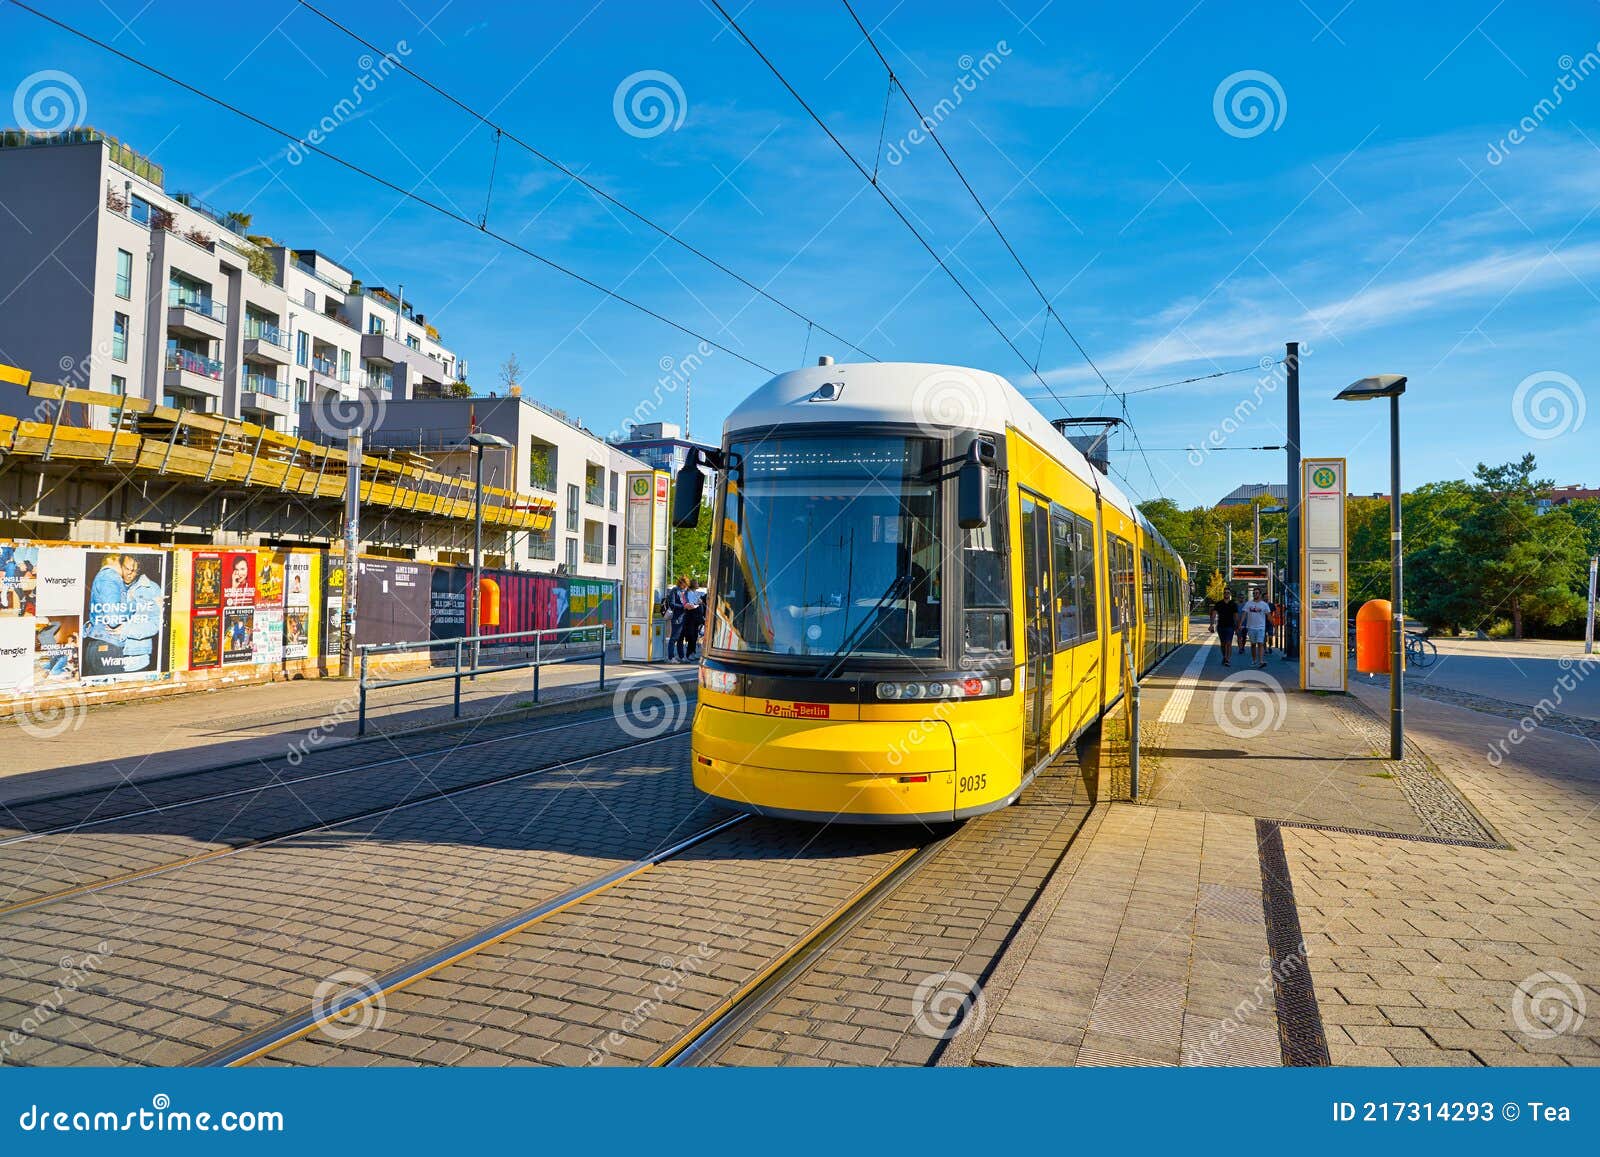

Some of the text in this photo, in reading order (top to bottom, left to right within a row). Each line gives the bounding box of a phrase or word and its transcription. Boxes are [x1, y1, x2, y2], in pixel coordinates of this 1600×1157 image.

[44, 577, 77, 587] Wrangler
[570, 585, 586, 596] BERLIN
[90, 601, 155, 613] ICONS LIVE
[94, 614, 149, 626] FOREVER
[0, 647, 28, 658] rangler
[765, 700, 827, 716] be Berlin
[960, 773, 987, 793] 9035
